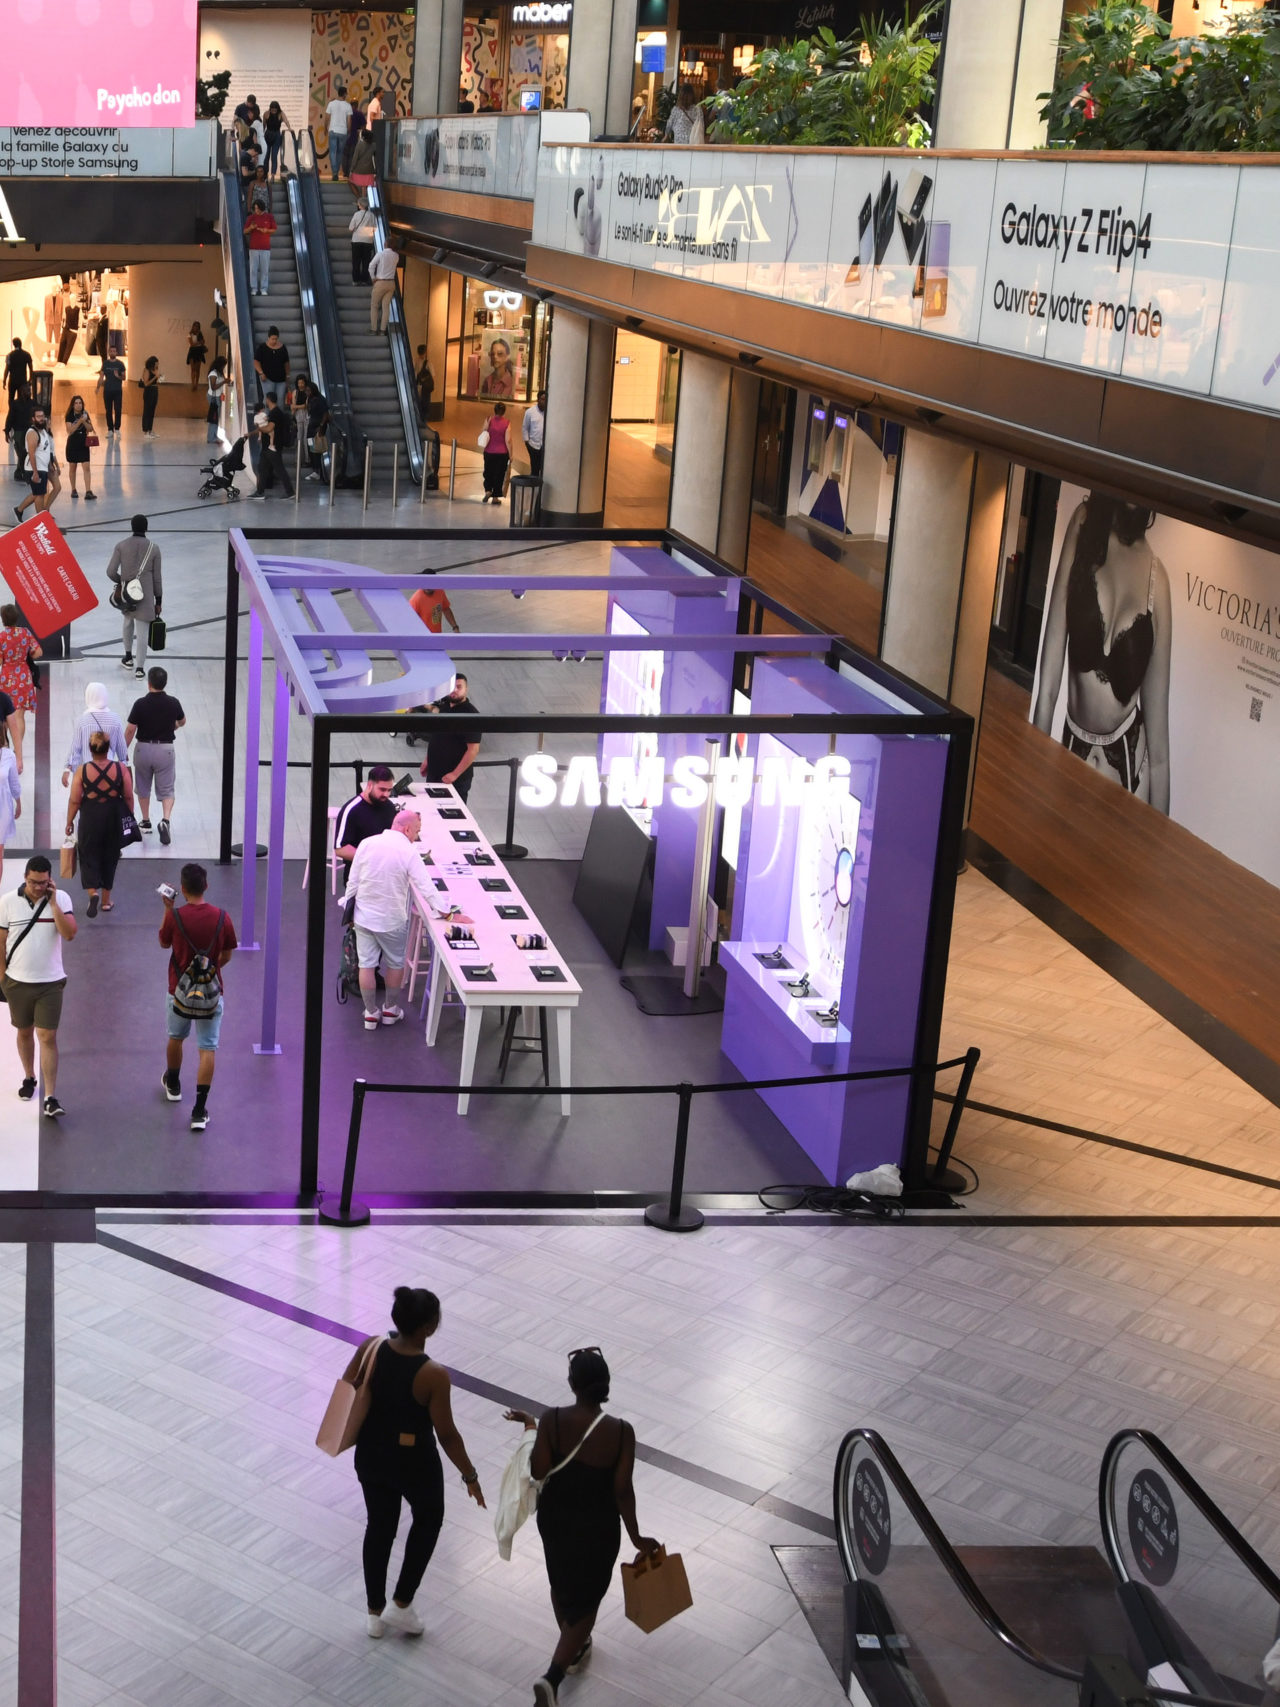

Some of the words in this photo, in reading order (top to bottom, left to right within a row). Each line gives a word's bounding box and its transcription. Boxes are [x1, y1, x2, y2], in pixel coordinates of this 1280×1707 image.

[1, 141, 12, 152] la
[17, 141, 59, 152] famille
[63, 142, 108, 155] Galaxy
[112, 143, 129, 152] au
[41, 157, 74, 168] Store
[78, 158, 138, 171] Samsung
[618, 171, 644, 206] Galaxy
[645, 173, 668, 200] Buds2
[670, 175, 683, 202] Pro
[615, 222, 621, 239] Le
[622, 225, 631, 241] son
[712, 242, 729, 260] sans
[1001, 202, 1077, 263] Galaxy
[1077, 208, 1093, 252] Z
[1095, 206, 1152, 272] Flip4
[994, 280, 1047, 317] Ouvrez
[1051, 292, 1092, 326] votre
[1096, 302, 1162, 338] monde
[34, 521, 57, 556] Westfield
[57, 565, 70, 582] CARTE
[65, 581, 80, 601] CADEAU
[1220, 628, 1264, 655] OUVERTURE
[519, 754, 852, 808] SAMSUNG
